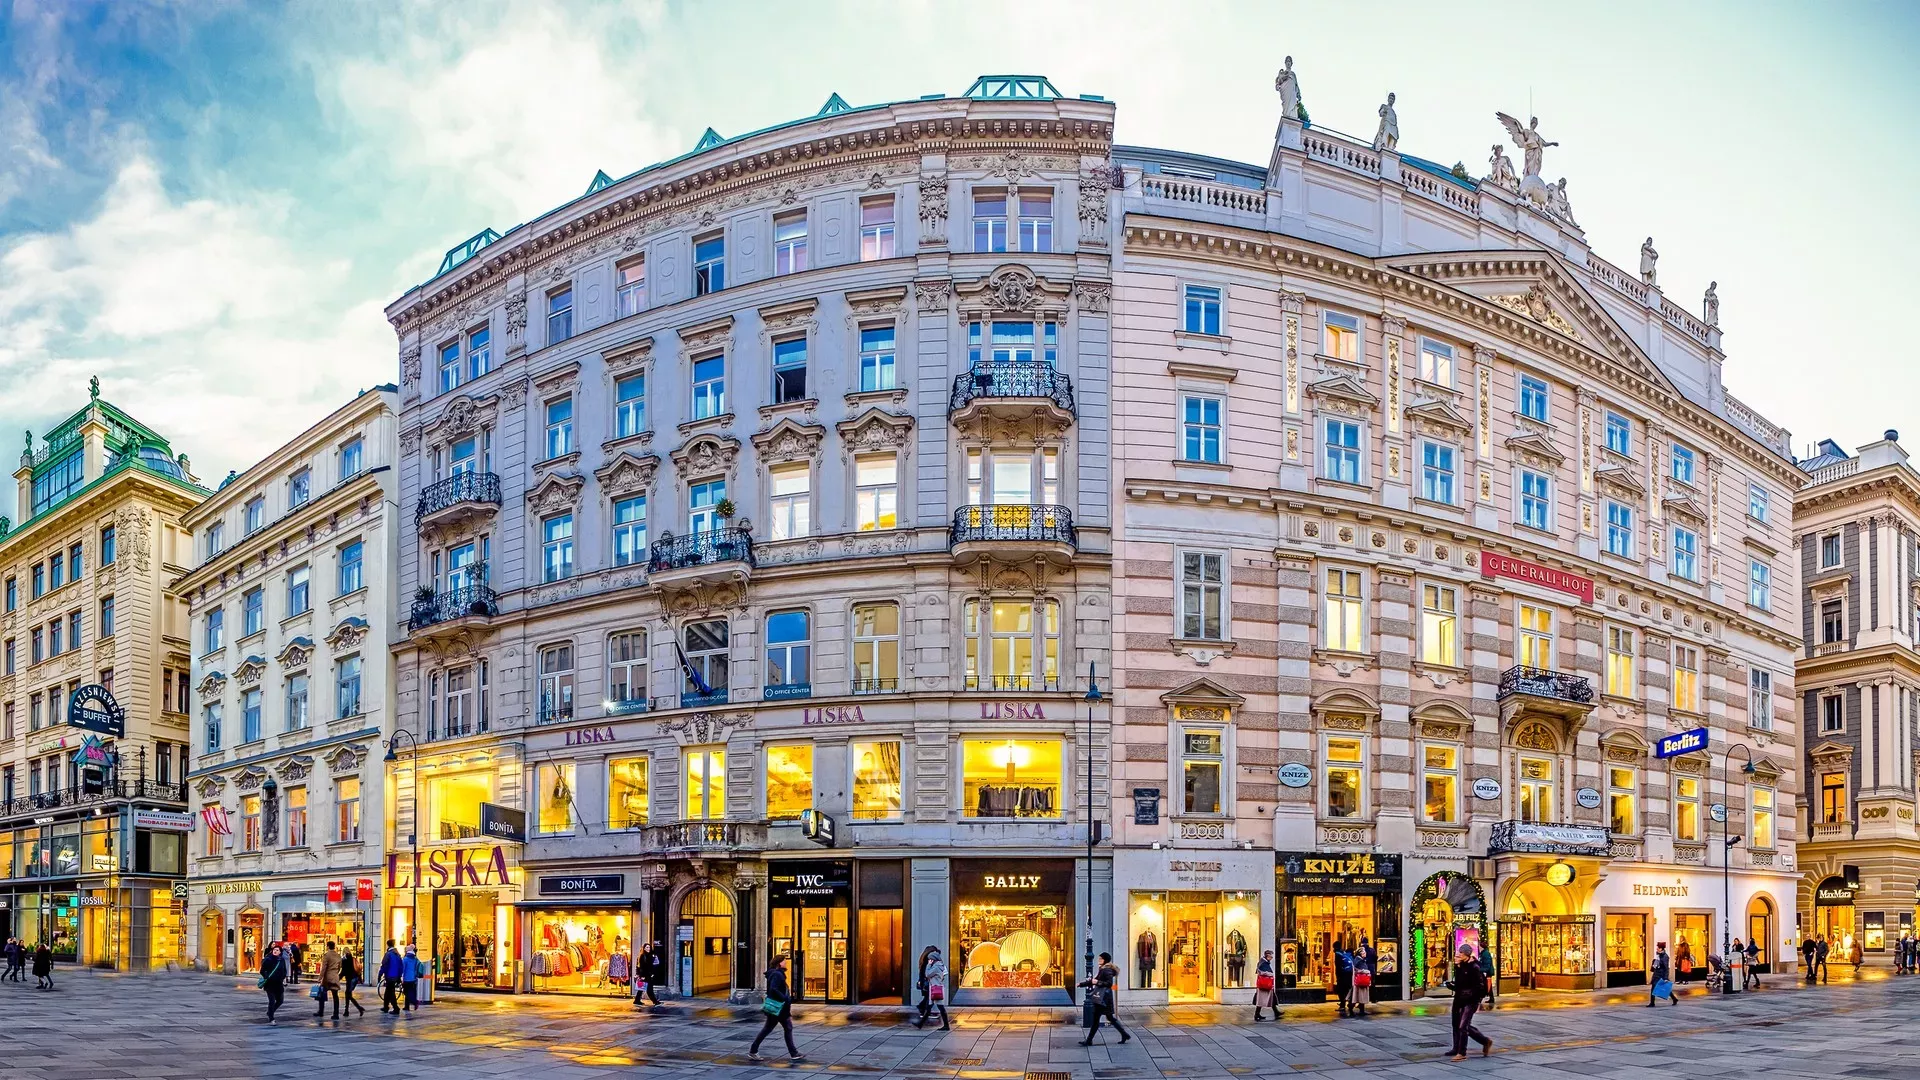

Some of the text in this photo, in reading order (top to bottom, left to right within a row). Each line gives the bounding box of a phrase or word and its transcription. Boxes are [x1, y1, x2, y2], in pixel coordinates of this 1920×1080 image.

[774, 688, 790, 696] OFFICE
[83, 710, 111, 724] BUFFET
[802, 705, 865, 725] LISKA
[980, 702, 1046, 720] LISKA
[564, 726, 616, 746] LISKA
[1664, 734, 1700, 753] Berlitz
[386, 846, 514, 890] LISKA
[1170, 860, 1222, 872] KNIZE
[1304, 859, 1375, 874] KNIZE
[205, 881, 263, 894] PAUL & SHARK
[796, 875, 824, 887] IWC
[984, 876, 1041, 888] BALLY
[329, 884, 342, 892] högl
[1633, 884, 1688, 897] HELDWEIN
[81, 896, 104, 905] FOSSIL
[1170, 892, 1206, 902] KNIZE
[289, 924, 306, 932] högl
